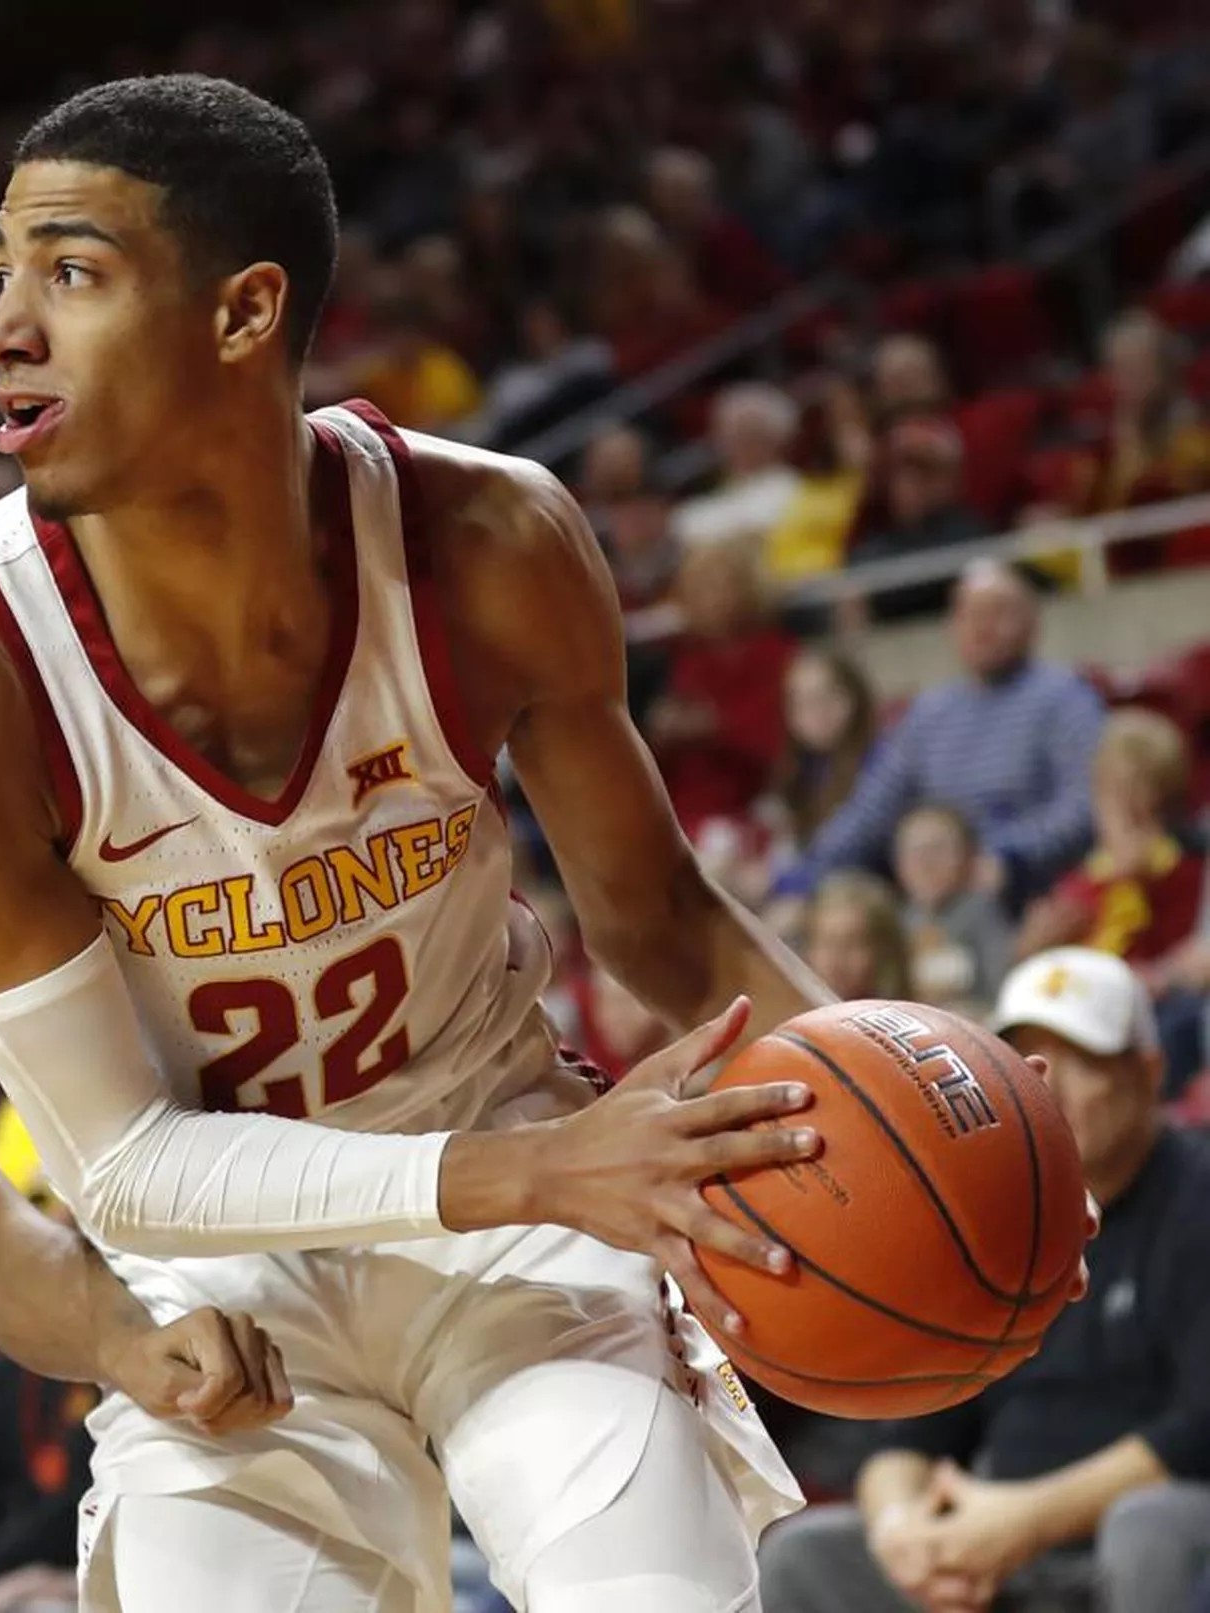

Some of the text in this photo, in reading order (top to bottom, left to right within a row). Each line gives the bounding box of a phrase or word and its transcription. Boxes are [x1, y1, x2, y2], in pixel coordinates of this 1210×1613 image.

[90, 803, 477, 959] YCLONES
[186, 934, 410, 1118] 22
[853, 1007, 1002, 1134] ELITE
